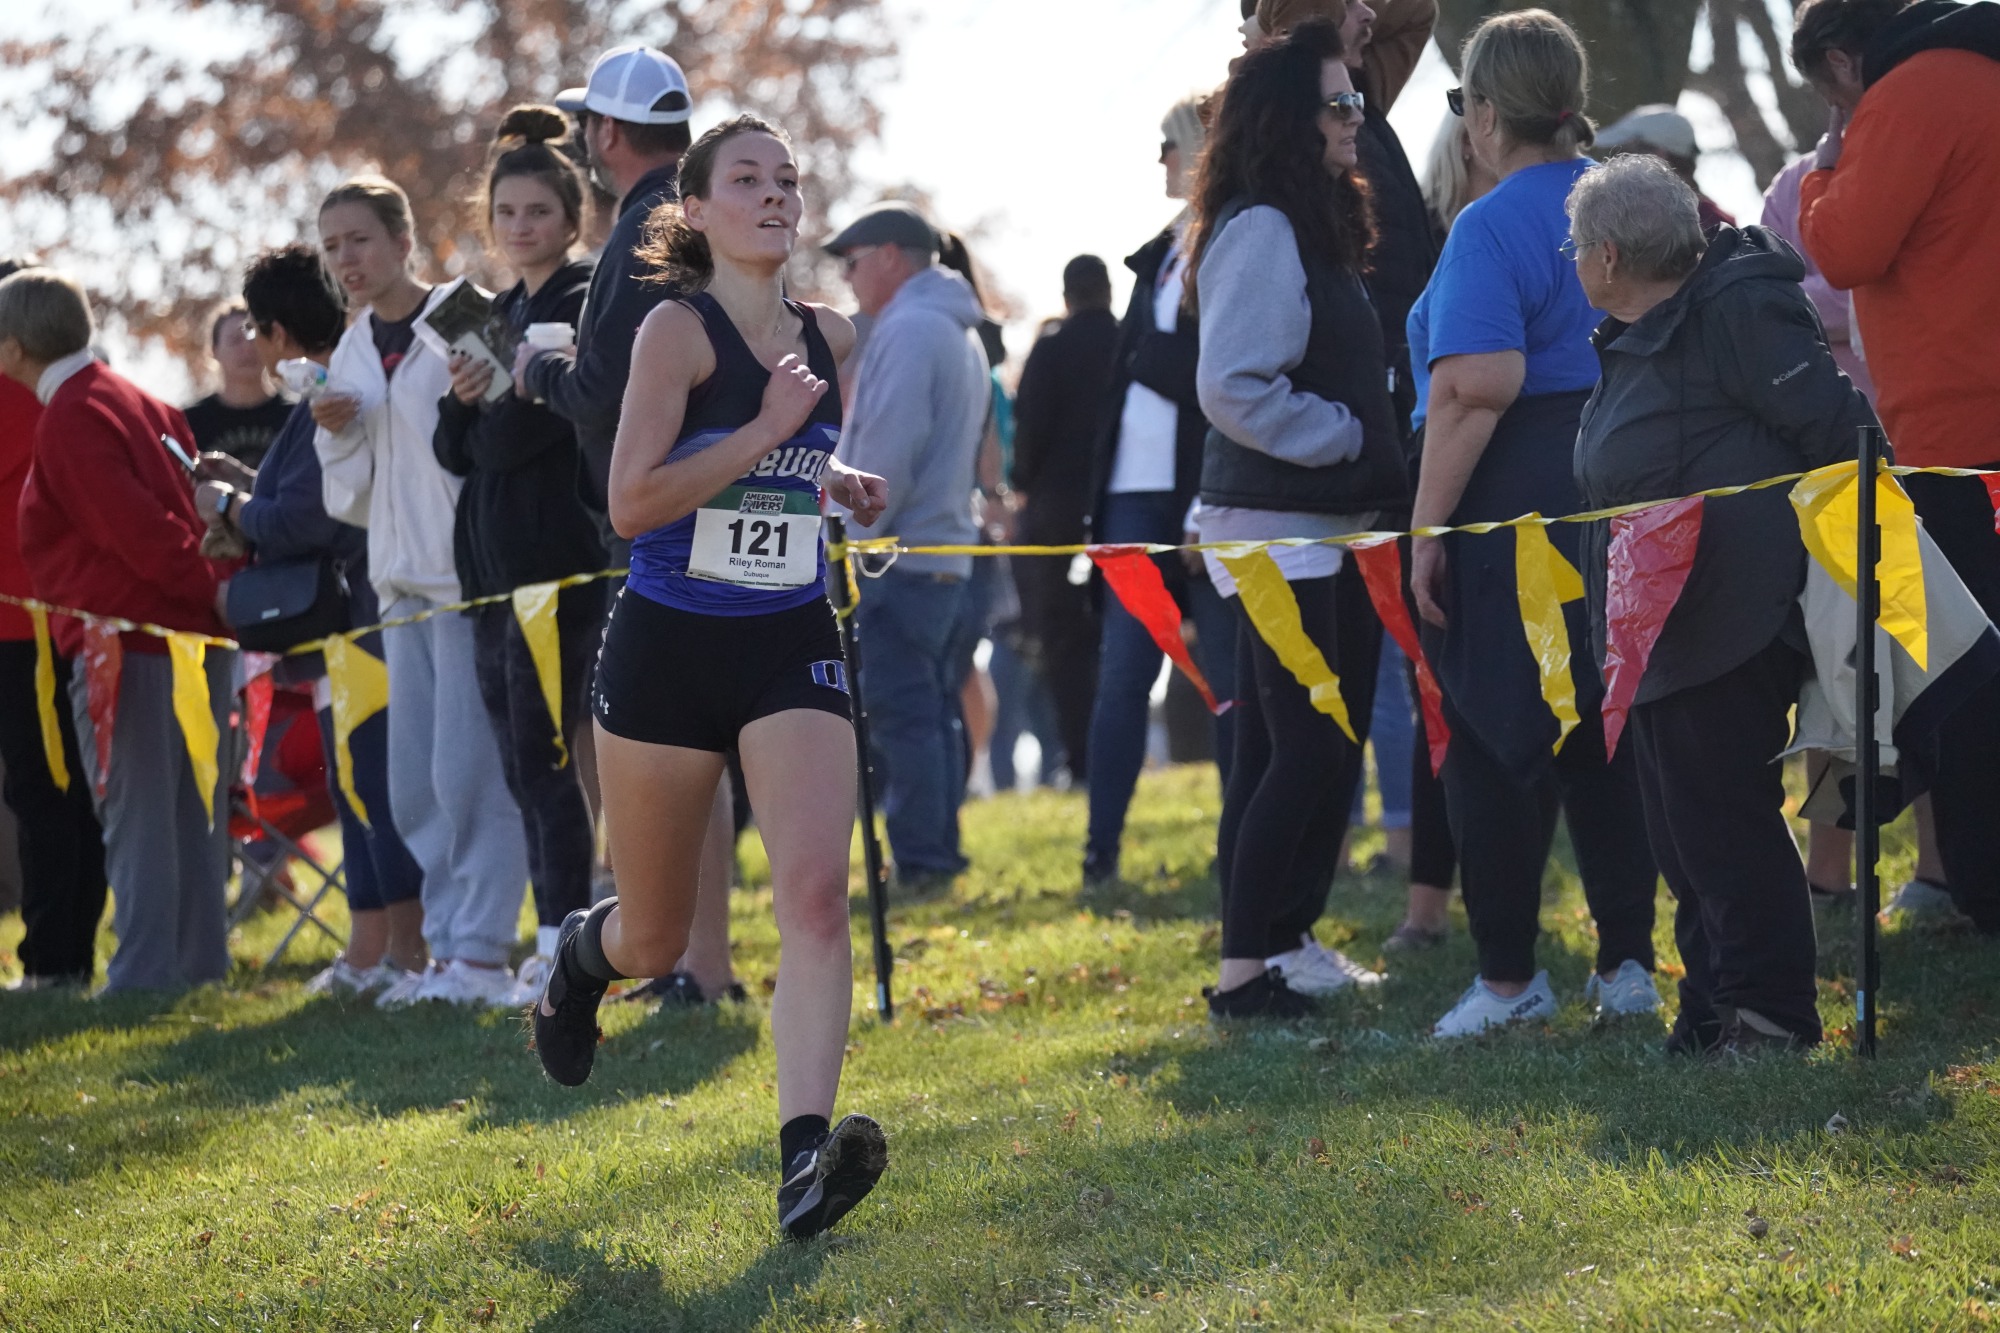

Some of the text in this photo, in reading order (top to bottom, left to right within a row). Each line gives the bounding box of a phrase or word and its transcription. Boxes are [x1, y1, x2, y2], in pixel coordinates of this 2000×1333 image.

[745, 493, 784, 502] AMERICAN
[728, 518, 789, 557] 121
[729, 557, 786, 569] Riley Roman
[743, 570, 770, 578] Dubuque
[1510, 994, 1543, 1018] HOKA
